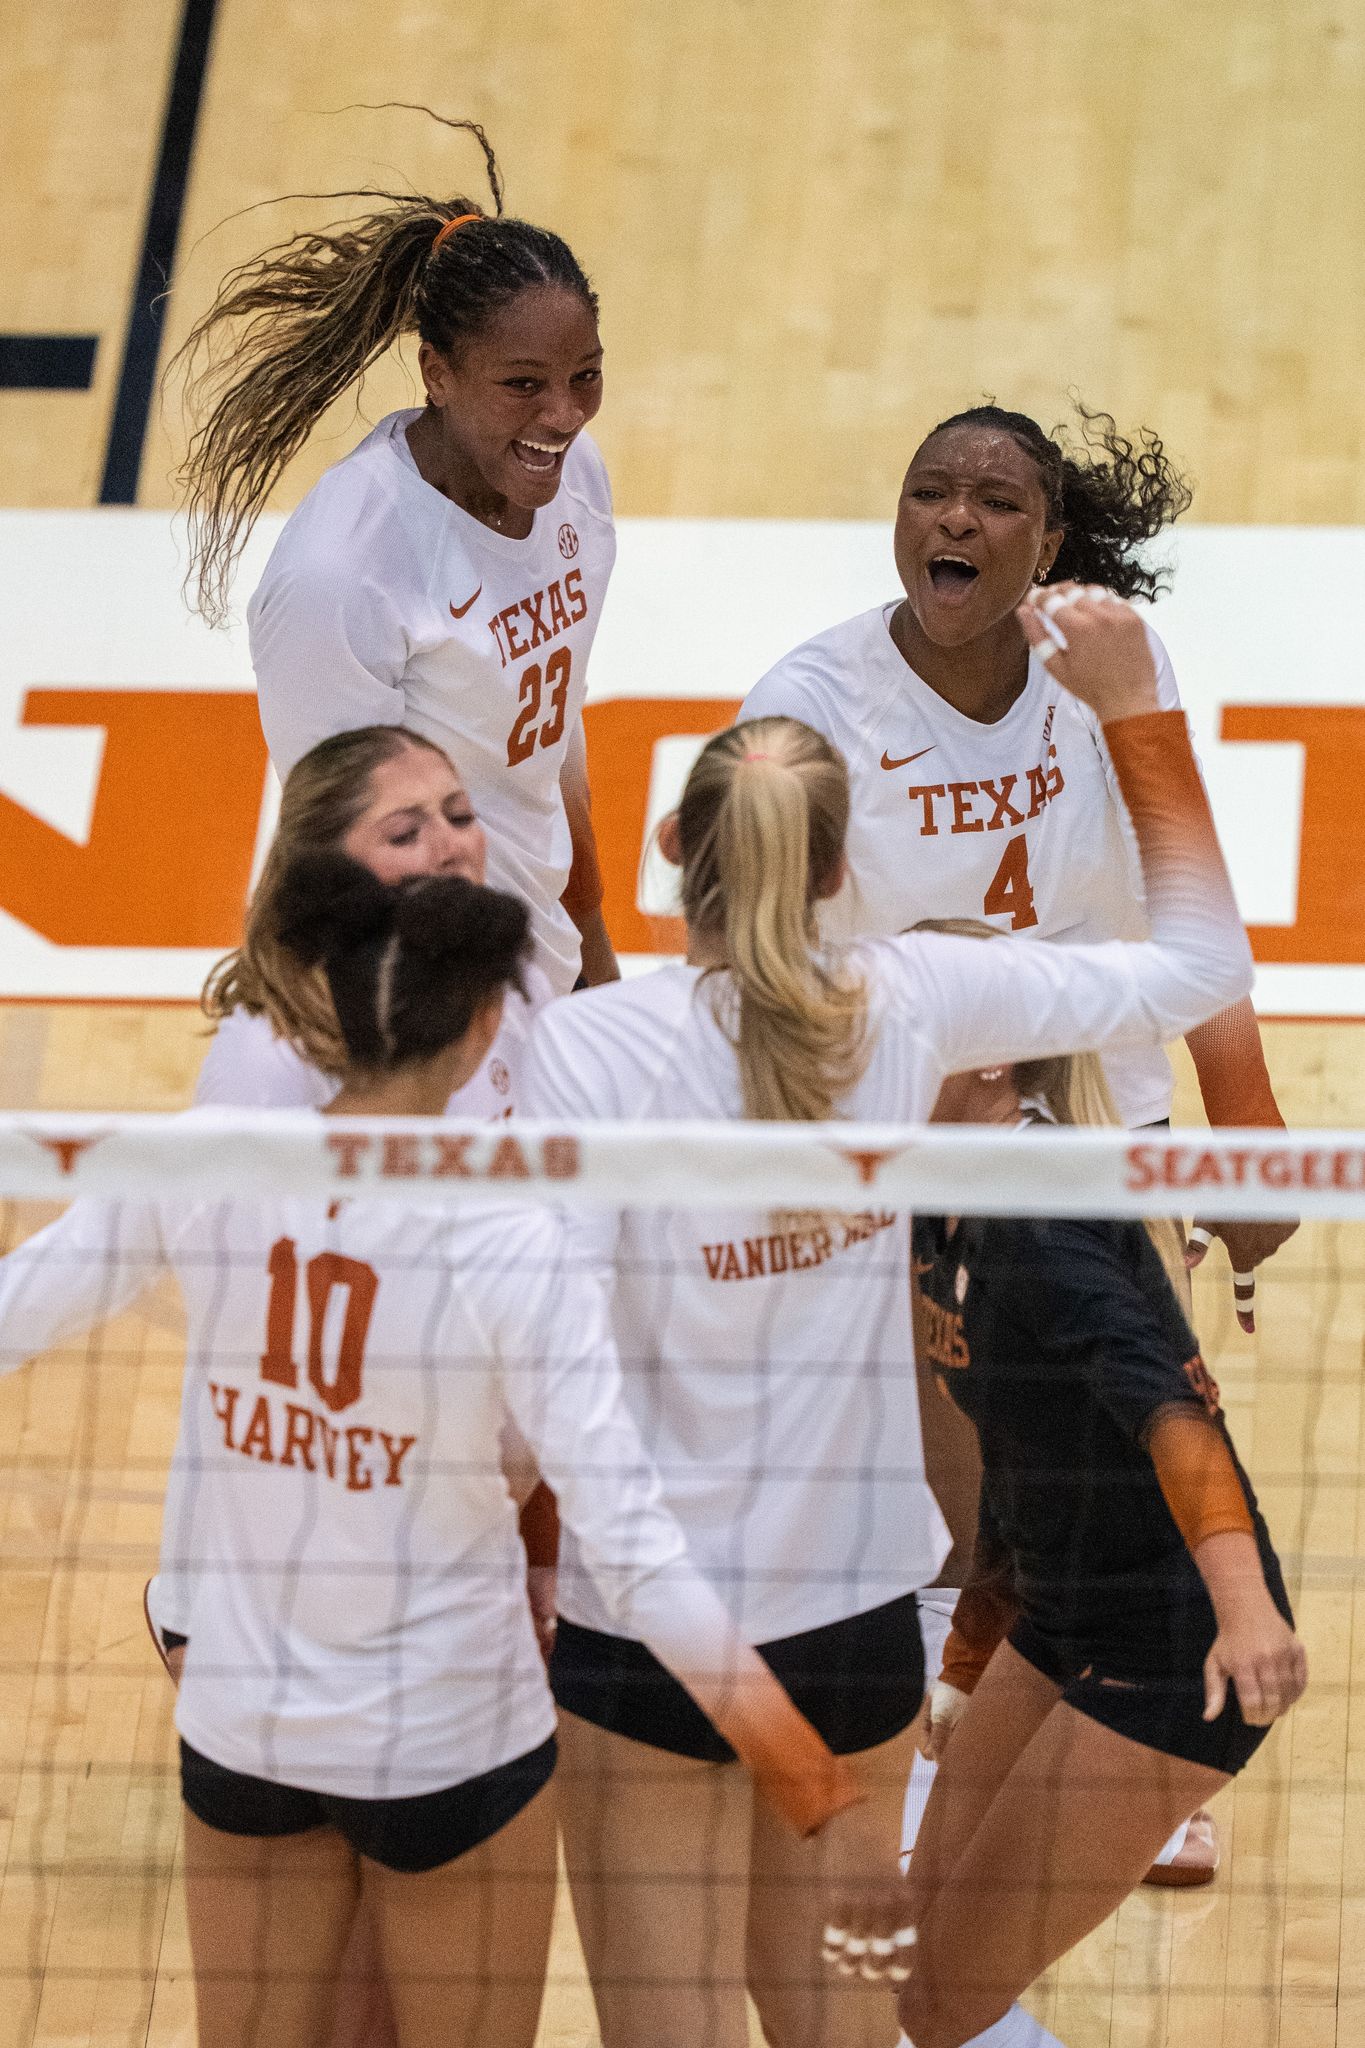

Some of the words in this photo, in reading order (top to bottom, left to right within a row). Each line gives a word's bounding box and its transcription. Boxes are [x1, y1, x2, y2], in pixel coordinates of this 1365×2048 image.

[487, 568, 588, 668] TEXAS
[507, 645, 572, 767] 23
[983, 833, 1039, 931] 4
[325, 1134, 581, 1179] TEXAS
[1125, 1144, 1365, 1192] SEATGEE
[260, 1236, 379, 1413] 10
[208, 1381, 416, 1491] HARVEY
